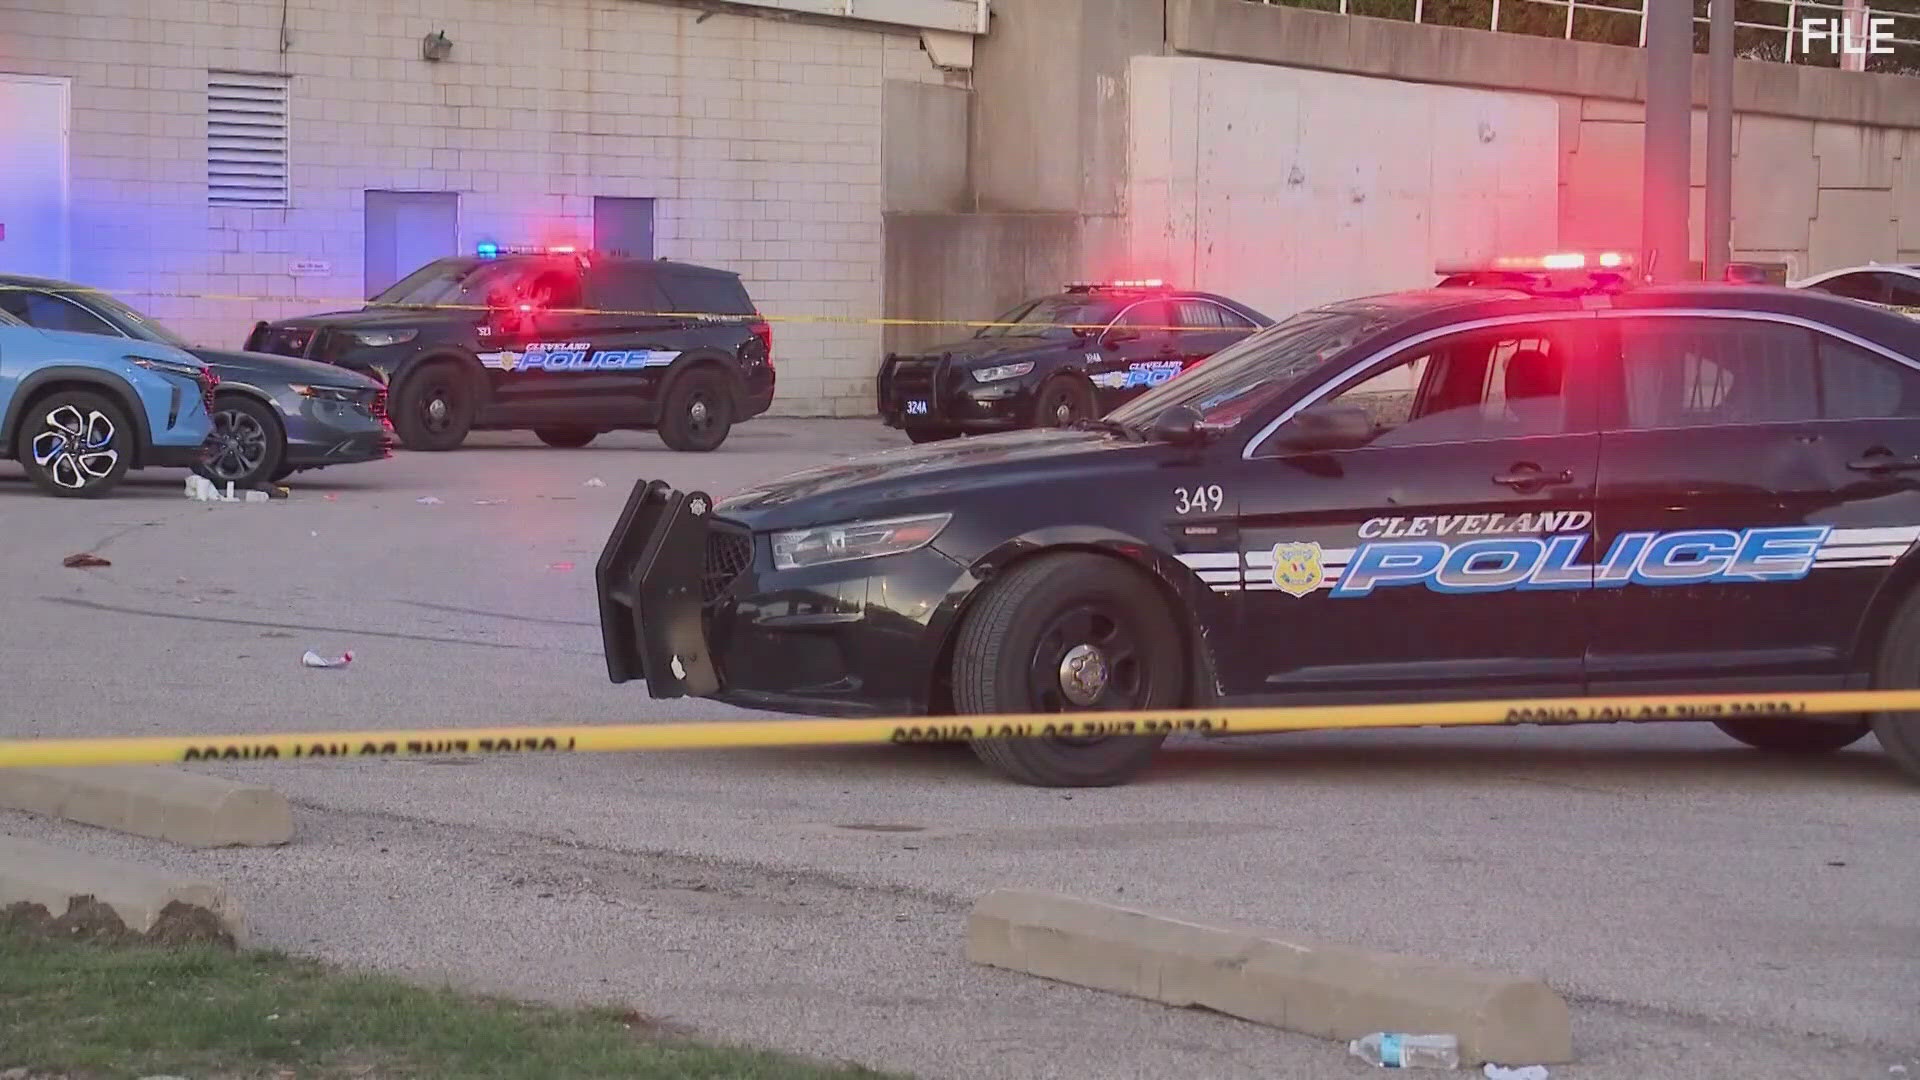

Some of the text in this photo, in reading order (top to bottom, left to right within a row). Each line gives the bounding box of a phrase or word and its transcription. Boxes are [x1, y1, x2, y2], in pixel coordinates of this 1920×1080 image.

[526, 343, 591, 351] CLEVELAND
[515, 350, 648, 372] POLICE
[1129, 361, 1184, 370] CLEVELAND
[906, 400, 928, 414] 324A
[1174, 485, 1224, 514] 349
[1357, 510, 1593, 539] CLEVELAND
[1328, 525, 1833, 599] POLICE
